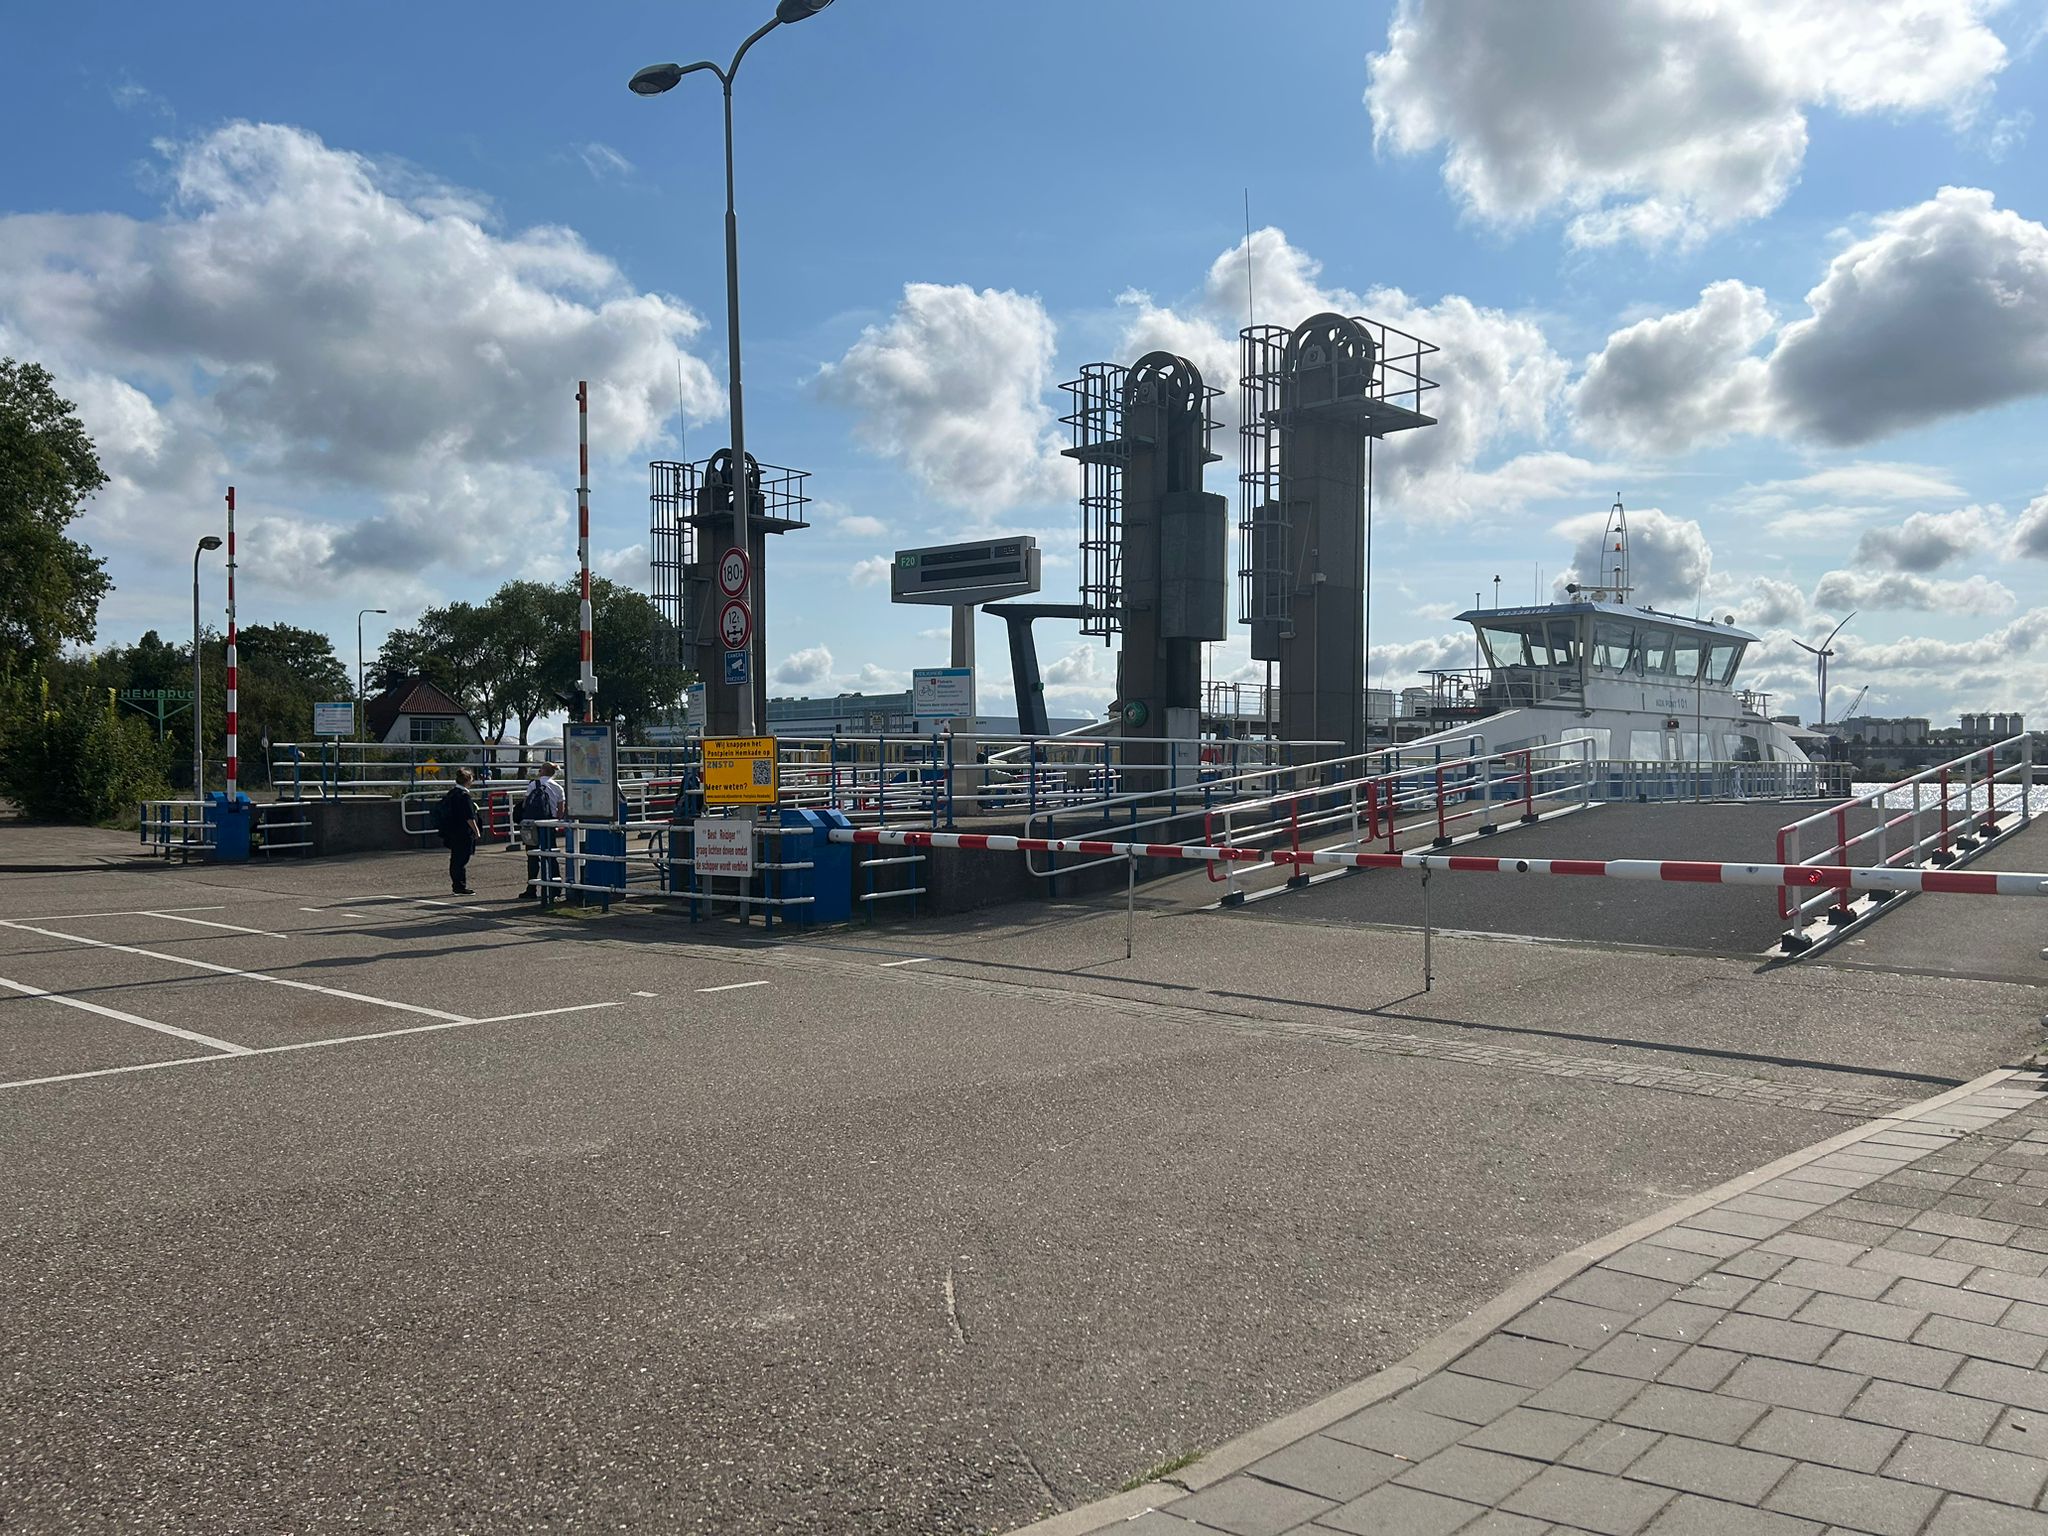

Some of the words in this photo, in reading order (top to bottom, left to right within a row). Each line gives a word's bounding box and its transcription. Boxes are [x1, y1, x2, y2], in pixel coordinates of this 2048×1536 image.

[901, 556, 915, 567] F20
[726, 741, 751, 750] knappen
[751, 740, 762, 748] het
[735, 748, 762, 757] Hemkade
[762, 749, 771, 757] op
[723, 782, 748, 791] weten?
